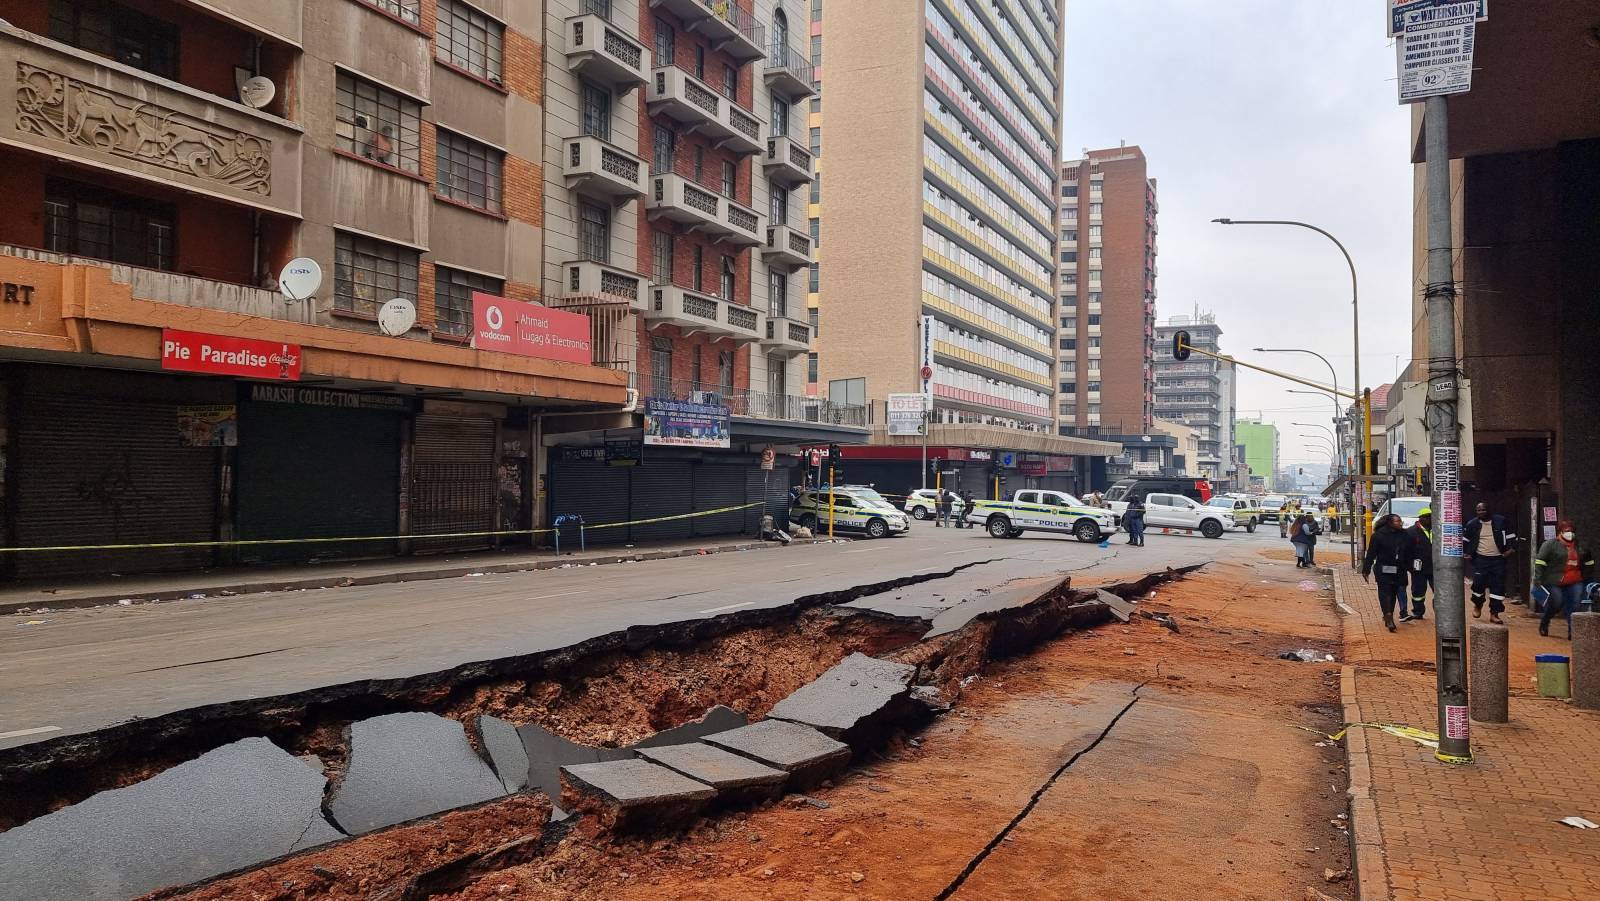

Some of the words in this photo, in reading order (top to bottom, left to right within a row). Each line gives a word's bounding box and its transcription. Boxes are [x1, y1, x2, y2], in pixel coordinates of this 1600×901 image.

[1407, 22, 1443, 32] COMBINED
[1444, 17, 1473, 26] SCHOOL
[1405, 51, 1431, 61] AMENDED
[1432, 46, 1460, 56] SYLLABUS
[1406, 42, 1429, 51] MATRIC
[1431, 56, 1453, 66] CLASSES
[0, 283, 35, 305] RT
[480, 329, 511, 342] vodacom
[521, 330, 544, 345] Lugag
[545, 335, 551, 345] &
[552, 335, 589, 351] Electronics
[164, 341, 191, 360] Pie
[201, 345, 267, 368] Paradise
[252, 384, 295, 404] AARASH
[298, 388, 361, 408] COLLECTION
[1435, 461, 1448, 474] 306
[1448, 449, 1457, 491] ABORTION
[1435, 475, 1448, 491] 0156
[837, 519, 864, 527] POLICE
[1039, 519, 1069, 528] POLICE
[1448, 707, 1456, 738] ABORTION
